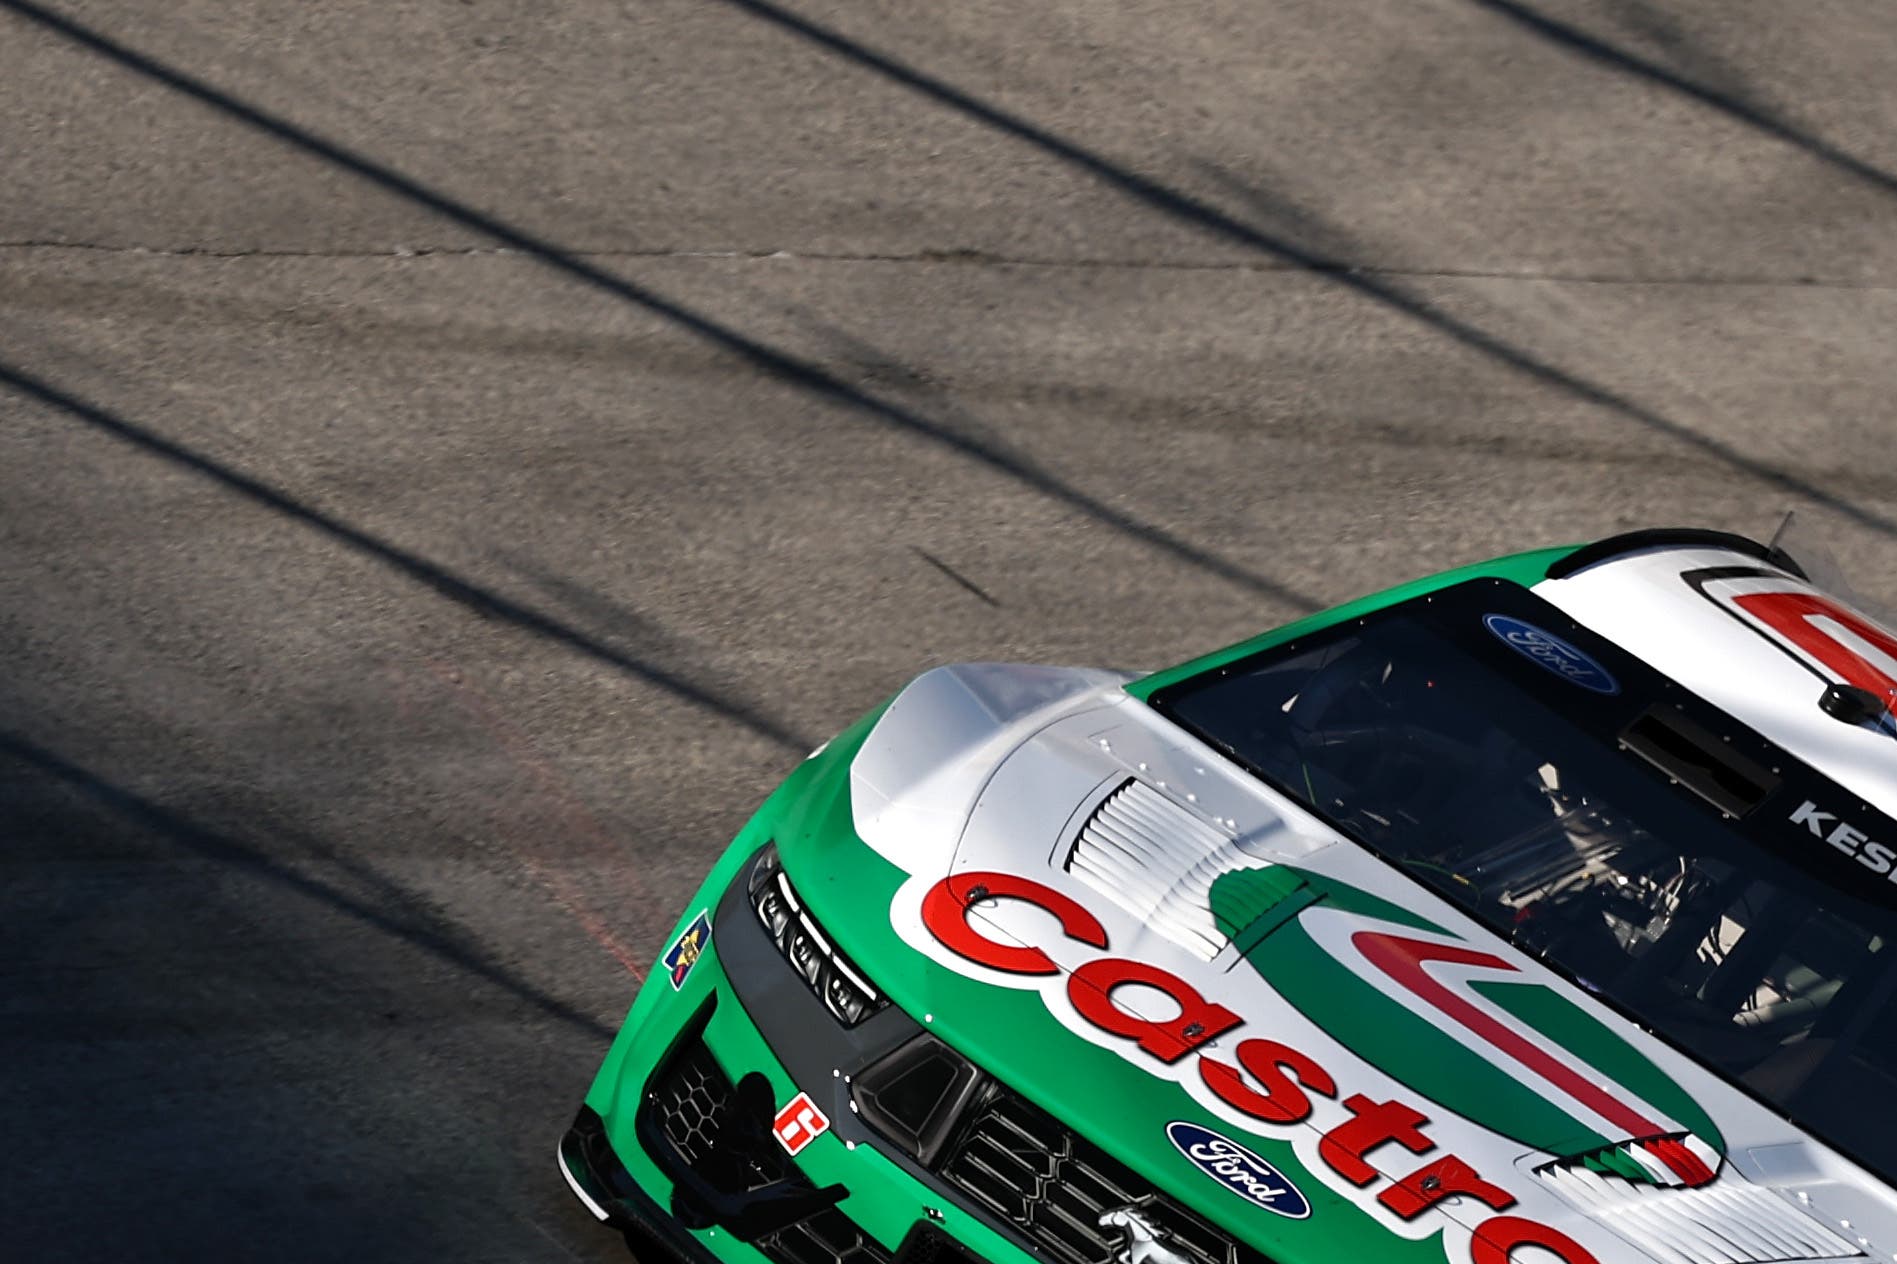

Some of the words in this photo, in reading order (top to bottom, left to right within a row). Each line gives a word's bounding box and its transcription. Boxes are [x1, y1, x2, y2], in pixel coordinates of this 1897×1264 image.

[1507, 631, 1595, 679] Ford
[773, 1093, 829, 1155] 6
[1189, 1140, 1287, 1203] Ford
